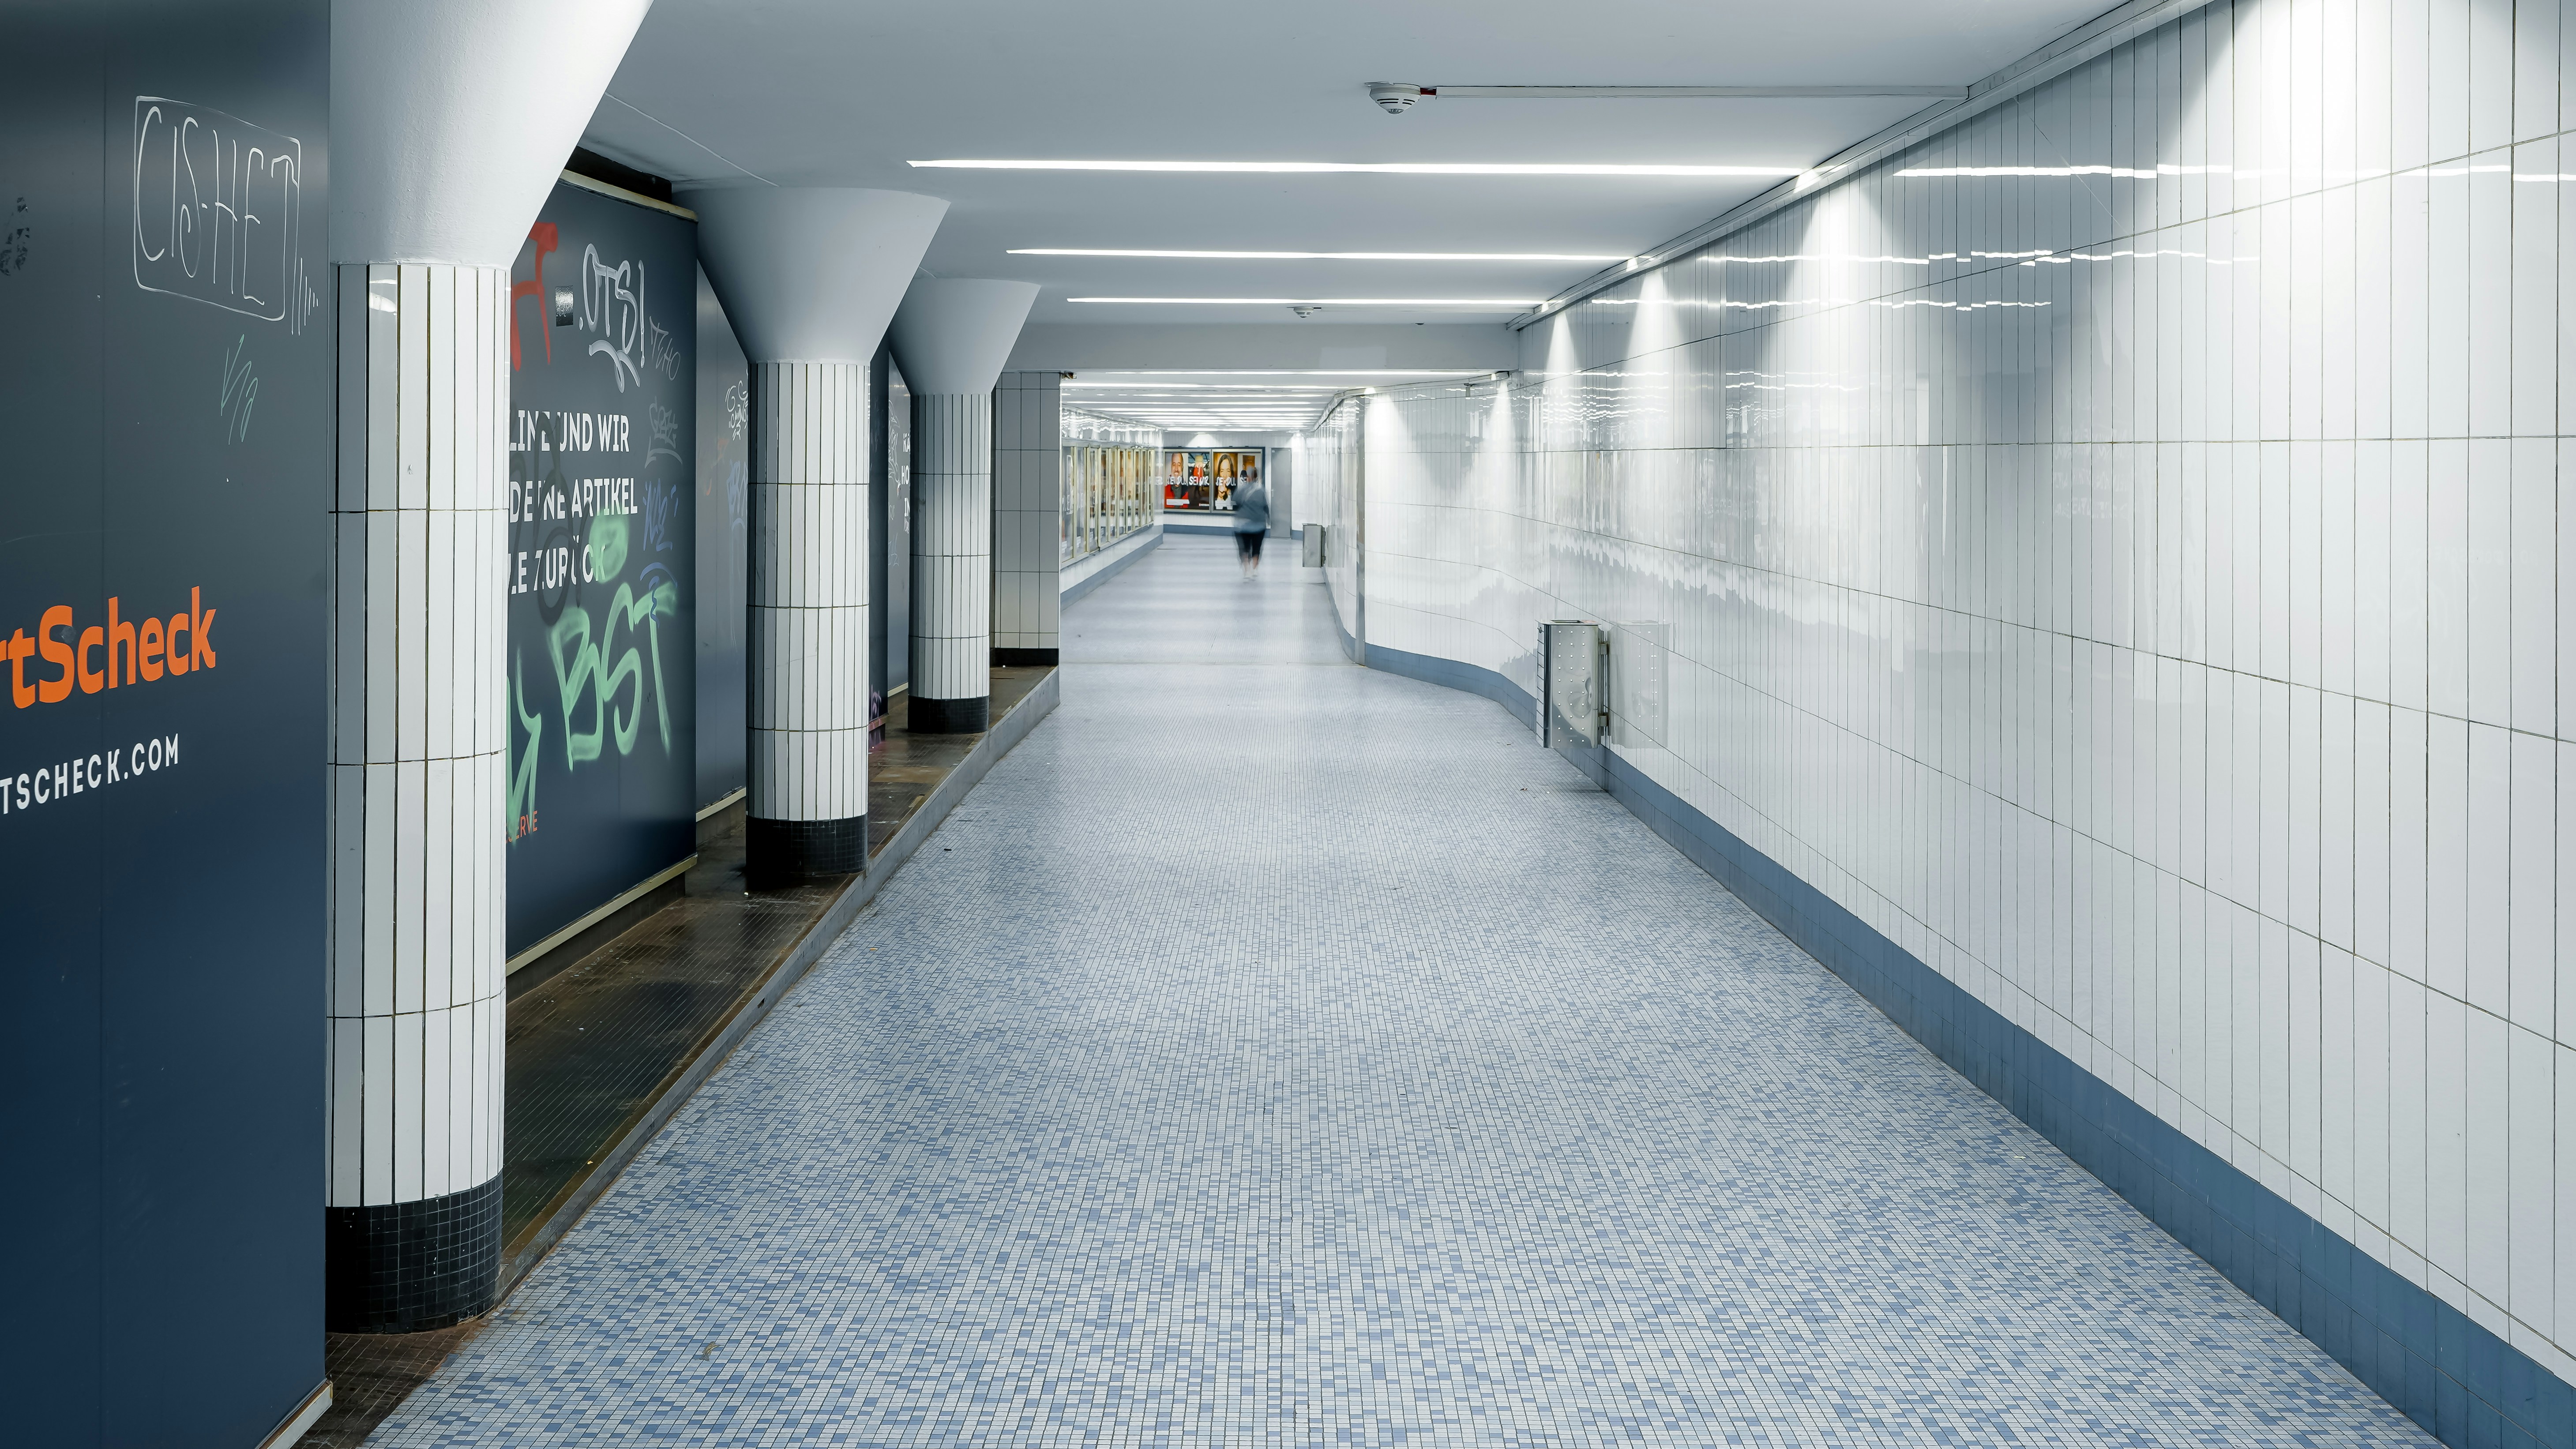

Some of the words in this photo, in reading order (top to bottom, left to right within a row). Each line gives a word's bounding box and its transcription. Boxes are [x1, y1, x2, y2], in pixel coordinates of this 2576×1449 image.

[557, 412, 593, 452] UND
[597, 414, 630, 452] WIR
[571, 477, 638, 518] ARTIKEL
[0, 586, 217, 709] tScheck
[0, 733, 179, 815] TSCHECK.COM
